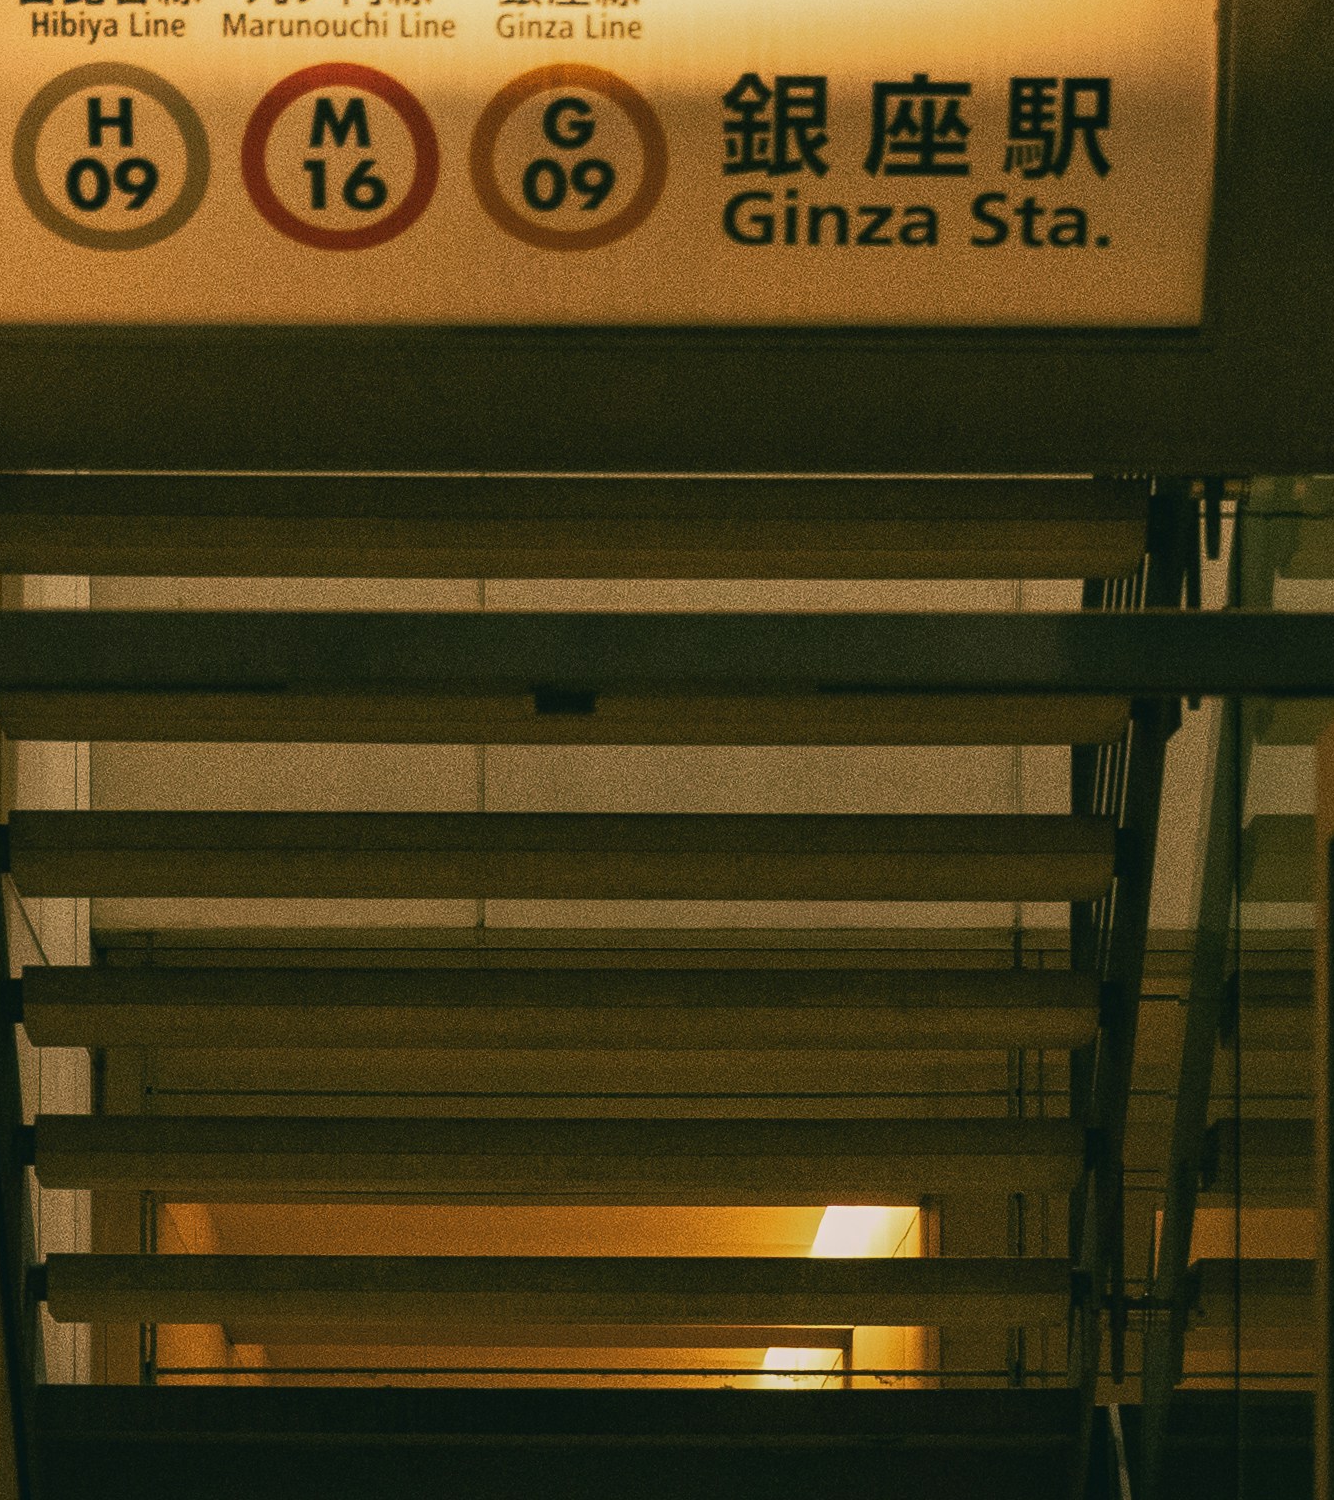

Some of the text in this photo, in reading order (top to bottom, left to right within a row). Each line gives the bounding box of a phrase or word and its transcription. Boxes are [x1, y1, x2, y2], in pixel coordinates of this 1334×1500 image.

[31, 11, 186, 45] Hibiya Line
[221, 11, 457, 39] Marunouchi Line
[495, 13, 643, 40] Ginza Line
[87, 97, 134, 148] H
[309, 97, 371, 148] M
[542, 97, 597, 150] G
[721, 72, 1114, 181] 銀座駅
[67, 157, 159, 211] 09
[304, 159, 389, 211] 16
[522, 158, 616, 212] 09
[722, 188, 1110, 249] Ginza Sta.
